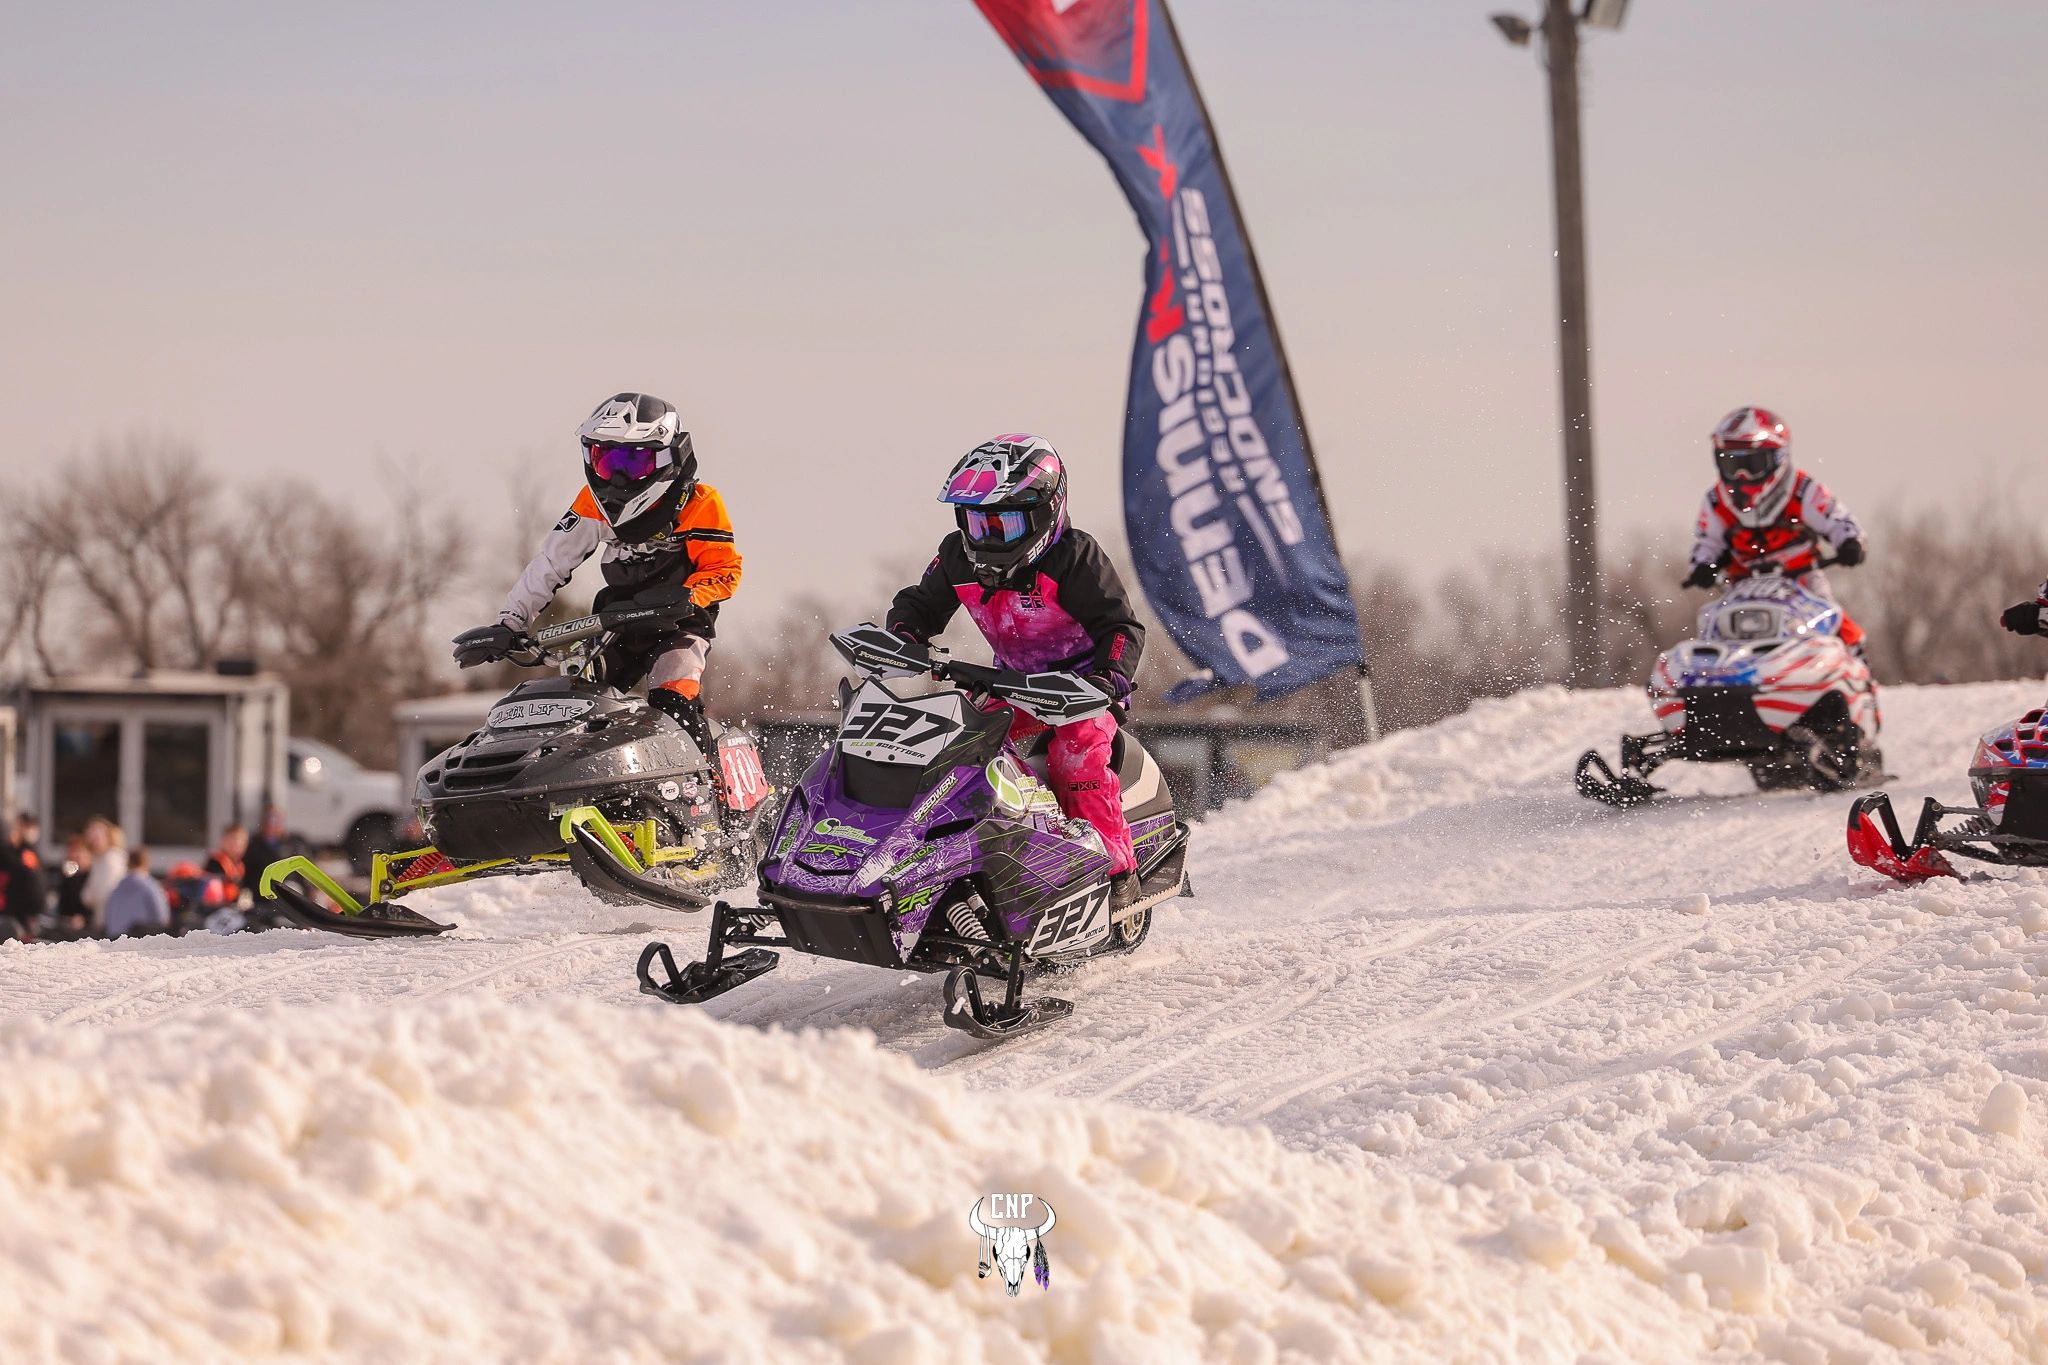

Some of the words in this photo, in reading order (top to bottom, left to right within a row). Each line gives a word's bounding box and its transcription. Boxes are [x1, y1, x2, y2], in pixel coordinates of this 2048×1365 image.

[1180, 188, 1304, 546] SNOCROSS
[1181, 266, 1248, 494] REGIONAL
[950, 489, 983, 498] FLY
[1026, 535, 1050, 562] 327
[626, 610, 655, 619] POLARIS
[543, 617, 597, 640] RACING
[528, 703, 584, 719] LIFTS
[838, 703, 963, 748] 327
[912, 772, 958, 823] SPEEDWERX
[800, 843, 848, 857] ZR
[888, 844, 938, 877] TSCHIDA
[897, 888, 932, 914] ZR
[1031, 885, 1111, 951] 327
